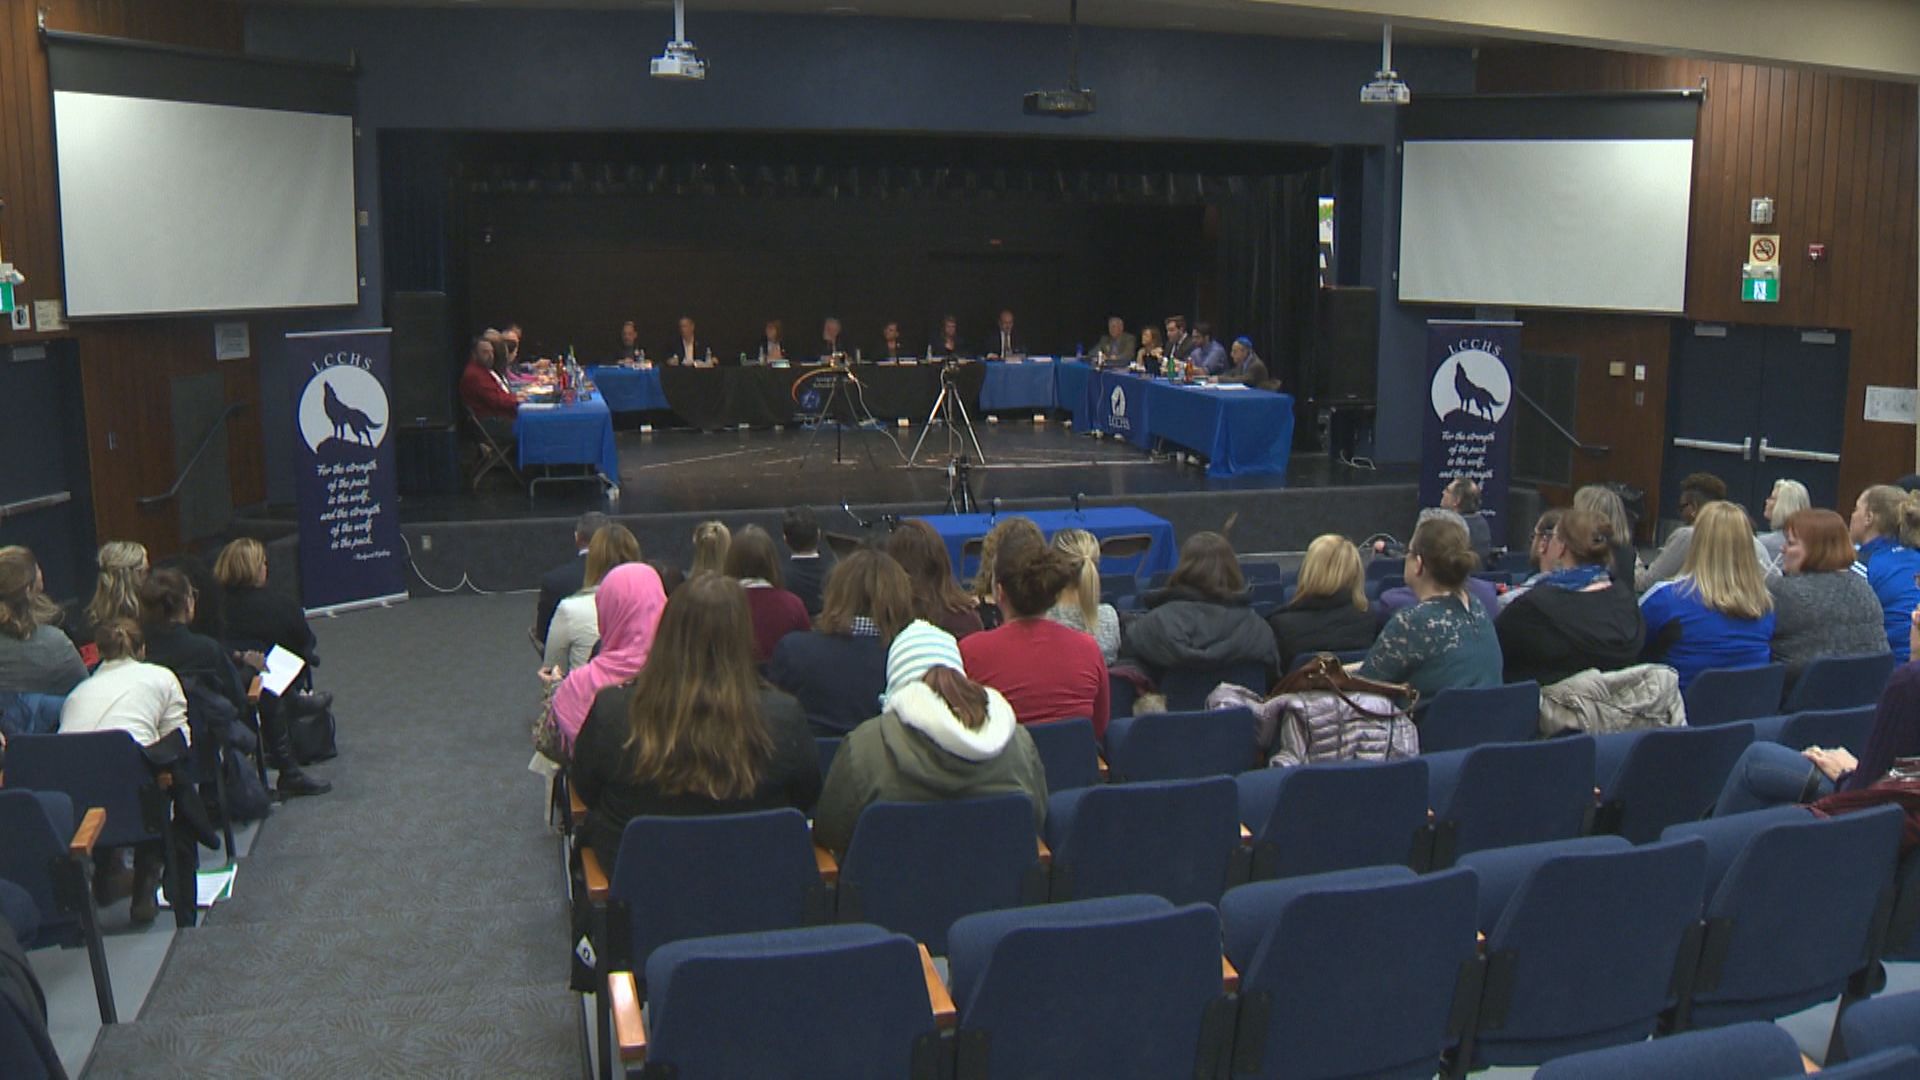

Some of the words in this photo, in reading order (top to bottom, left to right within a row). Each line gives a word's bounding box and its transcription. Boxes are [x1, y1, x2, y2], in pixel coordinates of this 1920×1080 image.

[1447, 338, 1502, 356] LCCHS
[311, 350, 373, 374] LCCHS
[316, 463, 332, 477] For
[332, 462, 345, 475] the
[327, 478, 338, 493] of
[338, 477, 350, 489] the
[337, 491, 349, 504] the
[337, 507, 349, 519] the
[330, 522, 341, 538] of
[341, 521, 353, 533] the
[340, 537, 352, 549] the
